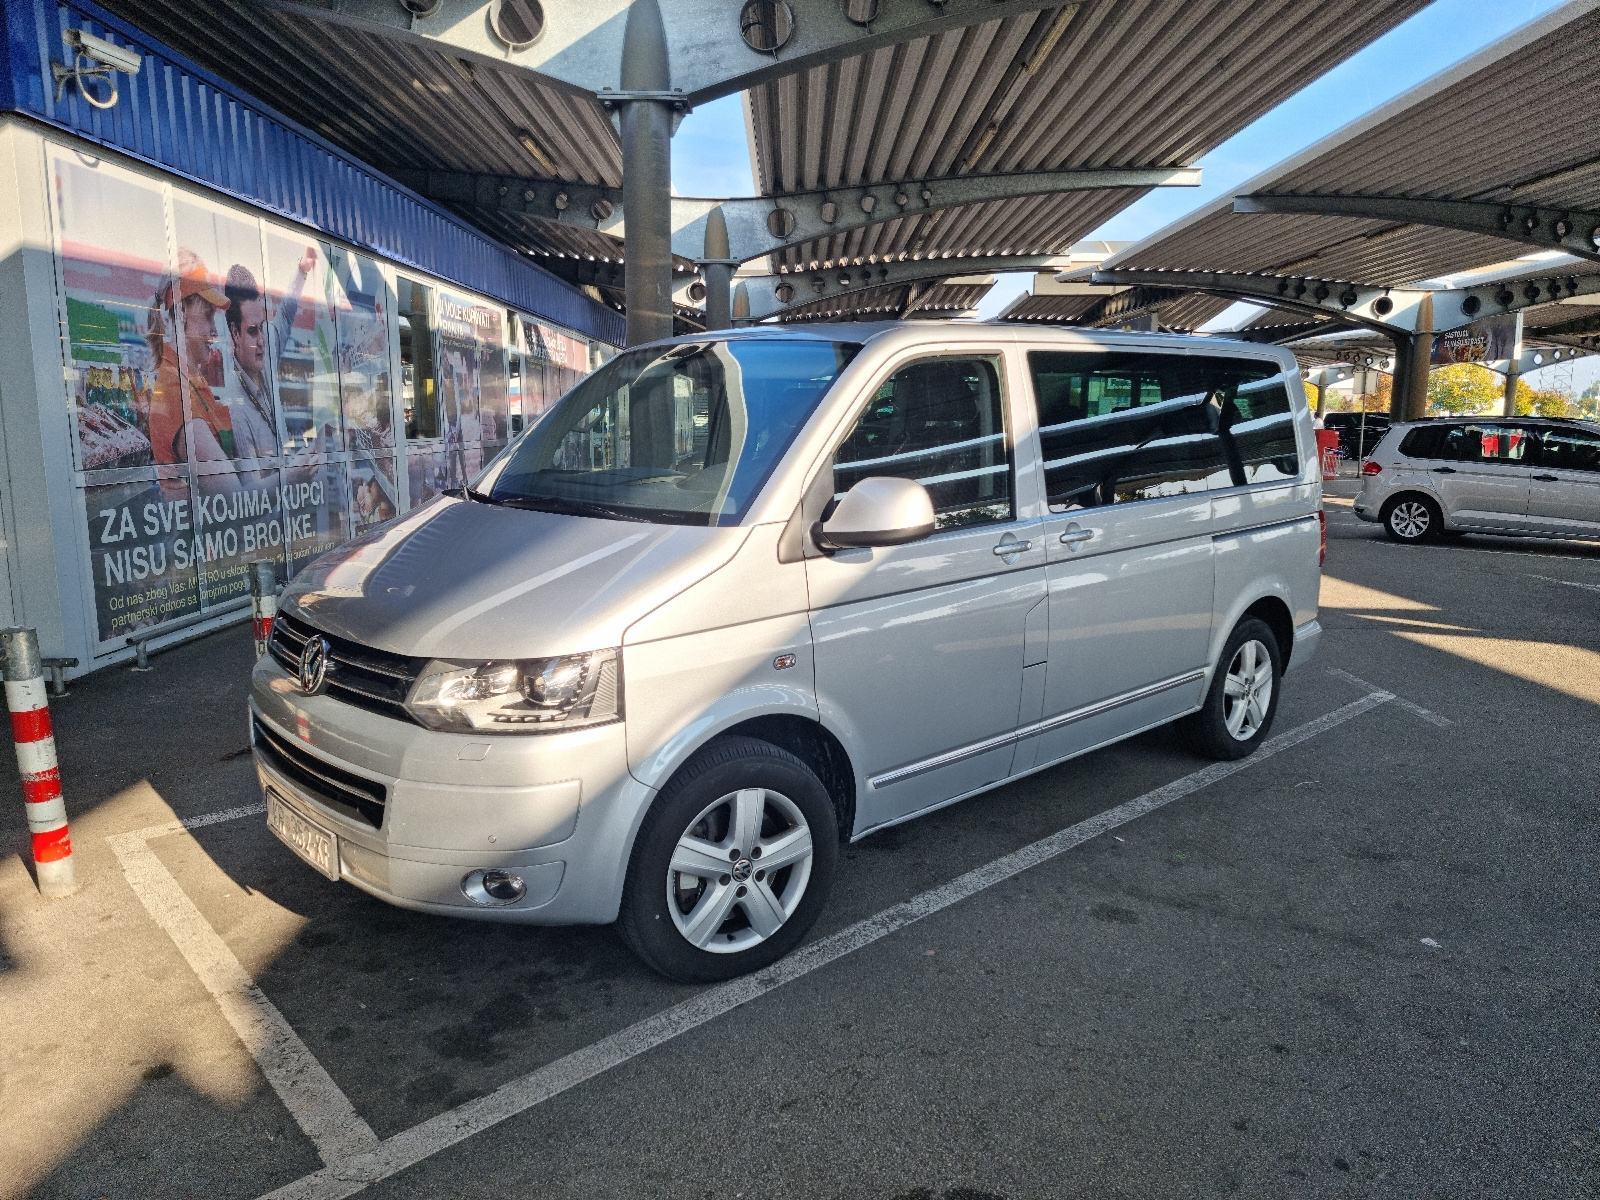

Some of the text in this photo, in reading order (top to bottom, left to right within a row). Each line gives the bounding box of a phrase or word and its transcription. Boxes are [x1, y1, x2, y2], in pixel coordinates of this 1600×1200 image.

[99, 481, 324, 544] ZA SVE KOJIMA KUPCI
[103, 513, 316, 587] NISU SAMO BROJKE.
[109, 595, 125, 611] Od
[127, 593, 144, 607] nas
[146, 587, 168, 602] zbog
[169, 581, 187, 595] Vas:
[111, 603, 158, 631] partnerski
[159, 598, 186, 614] odnos
[187, 594, 198, 606] sa
